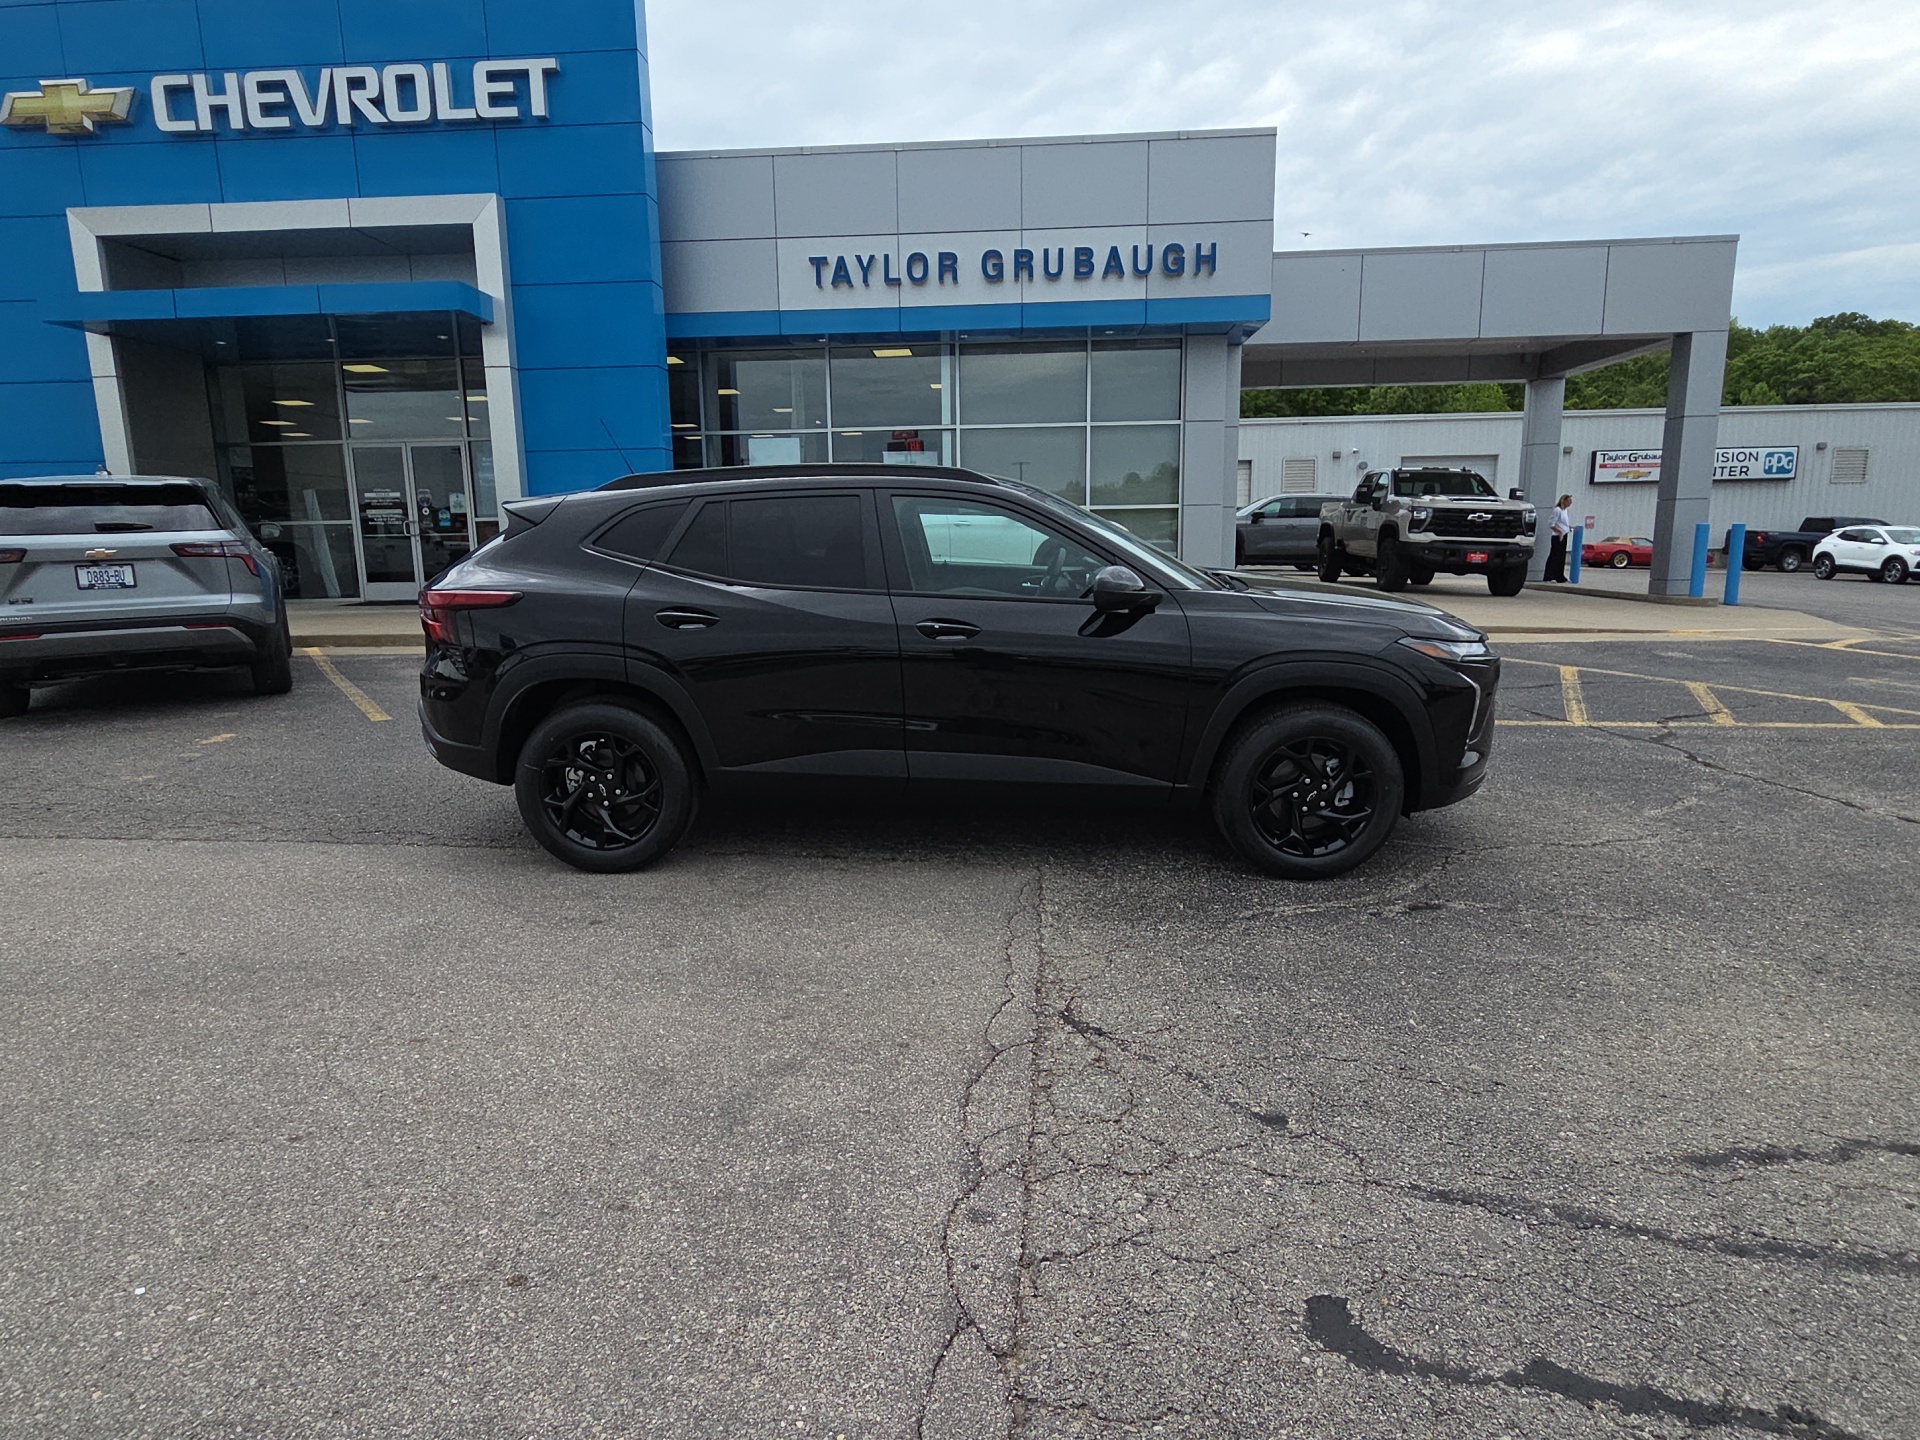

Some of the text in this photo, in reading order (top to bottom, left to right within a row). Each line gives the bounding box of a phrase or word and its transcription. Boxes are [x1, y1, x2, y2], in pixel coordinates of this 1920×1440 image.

[150, 58, 560, 134] CHEVROLET
[809, 242, 1218, 288] TAYLOR GRUBAUGH
[1600, 453, 1627, 463] Taylor
[1765, 453, 1794, 473] PPG
